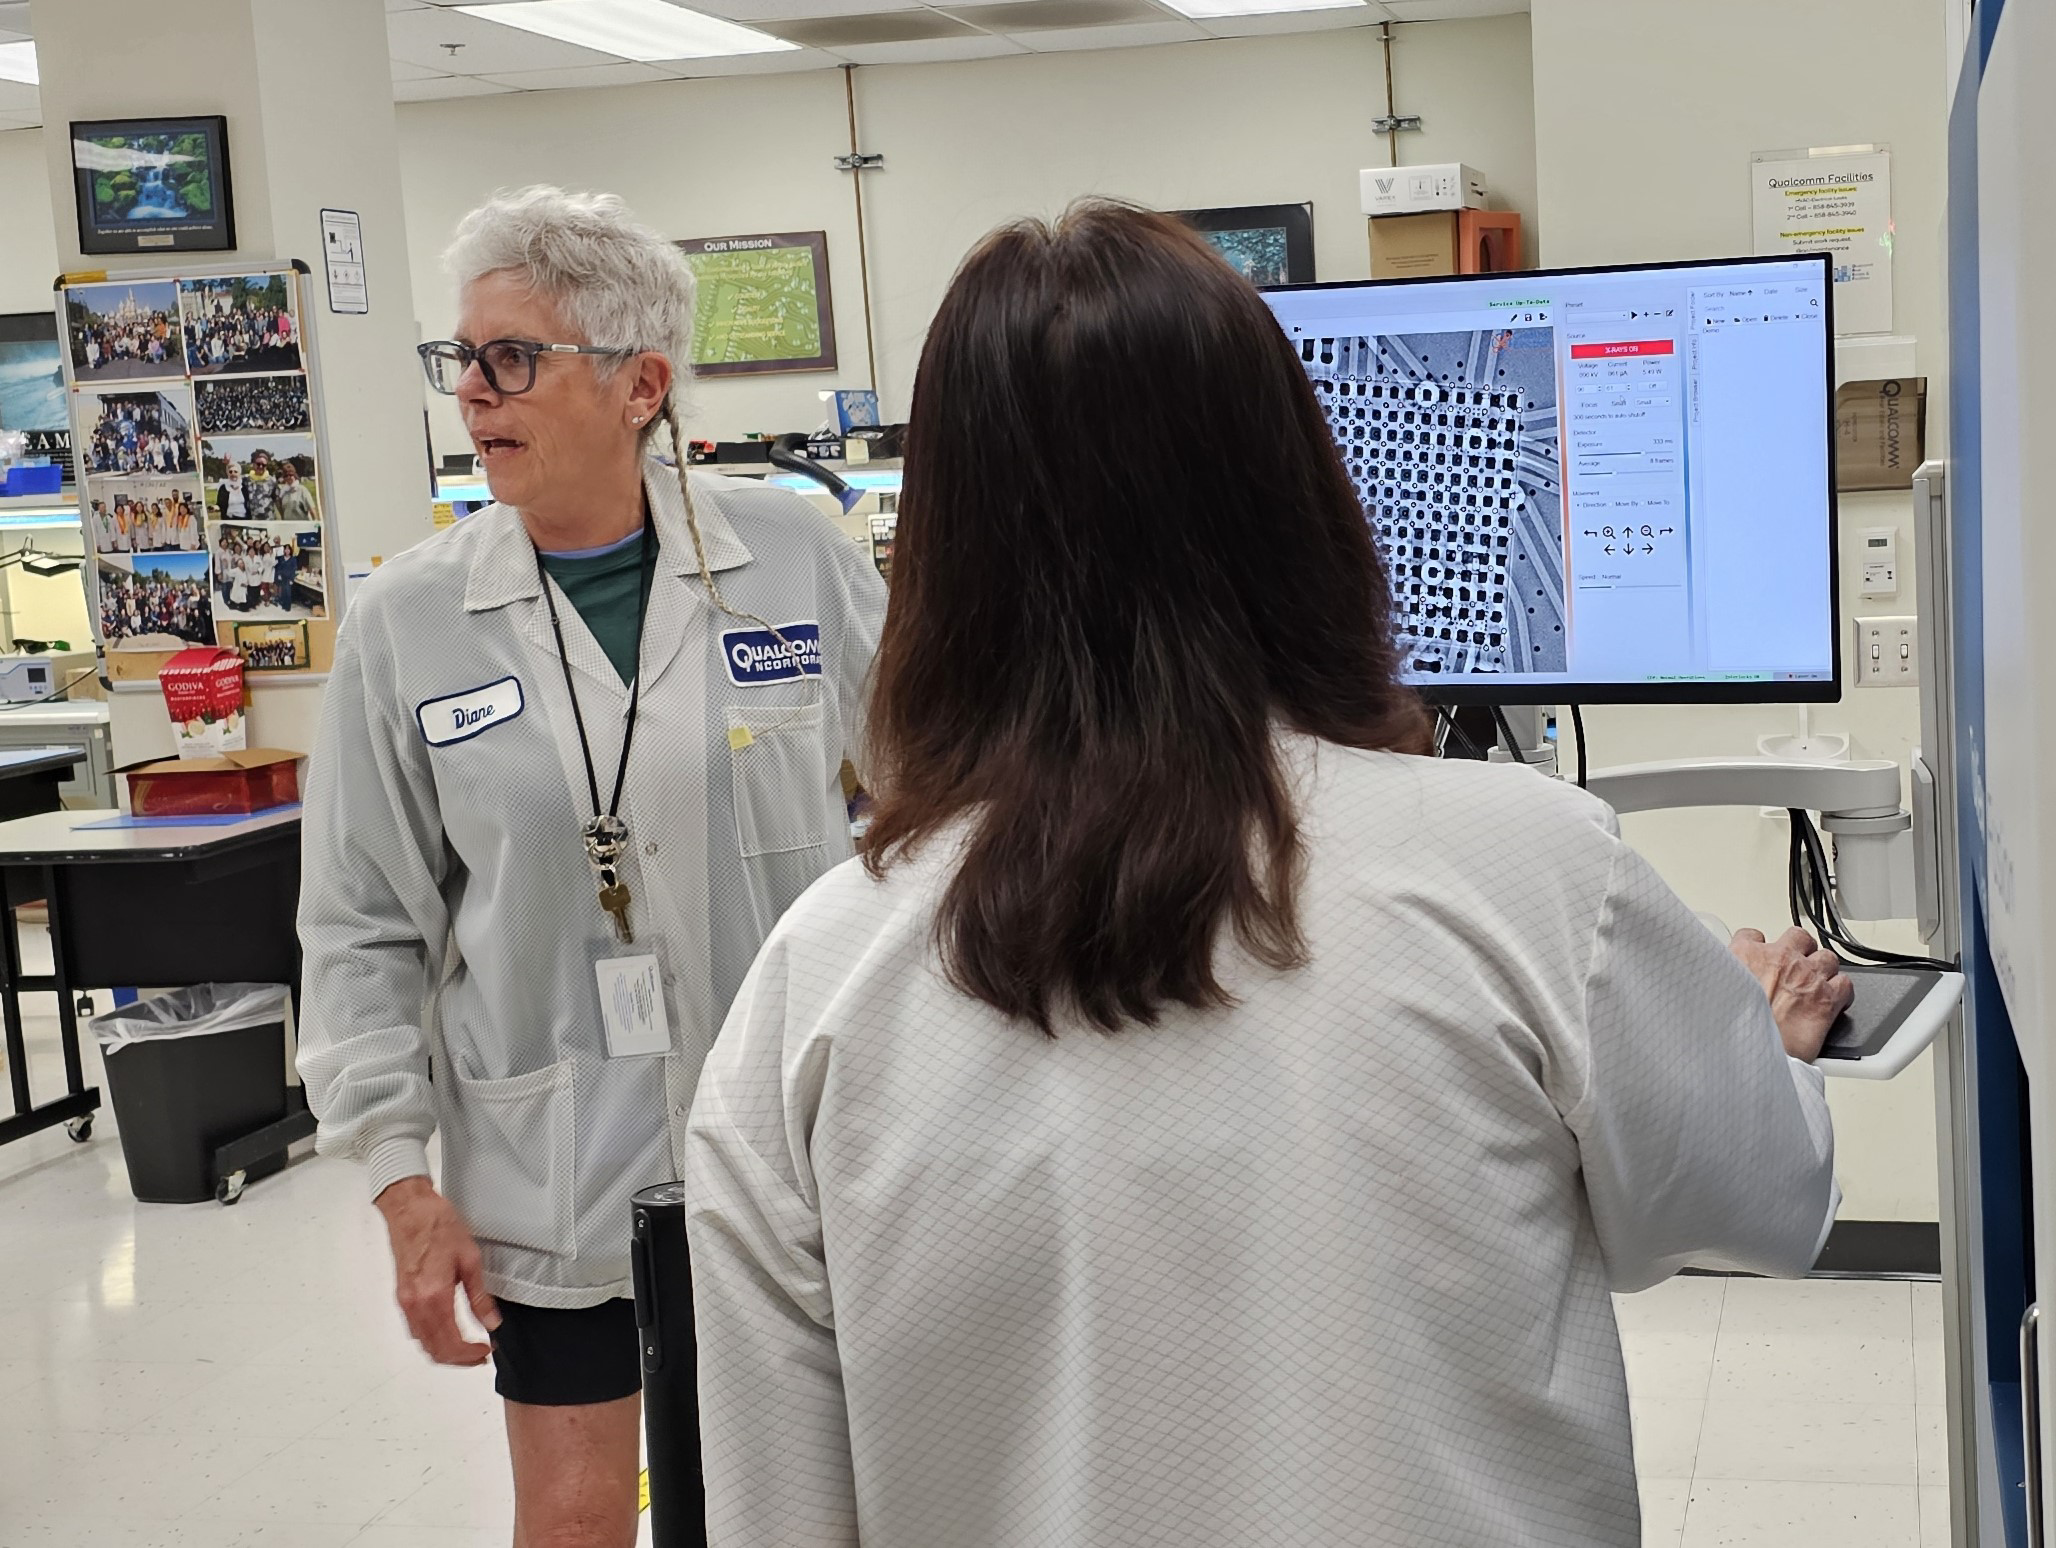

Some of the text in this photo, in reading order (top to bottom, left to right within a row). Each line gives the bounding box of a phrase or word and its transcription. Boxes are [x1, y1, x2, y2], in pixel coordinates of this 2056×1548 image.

[1768, 172, 1874, 188] Qualcomm Facilities
[1785, 189, 1817, 197] Emergency
[704, 239, 772, 252] OUR MISSION
[1881, 380, 1901, 467] QUALCOMM
[732, 638, 820, 672] QUALCOM
[168, 681, 204, 691] GODIVA
[452, 704, 496, 729] Diane
